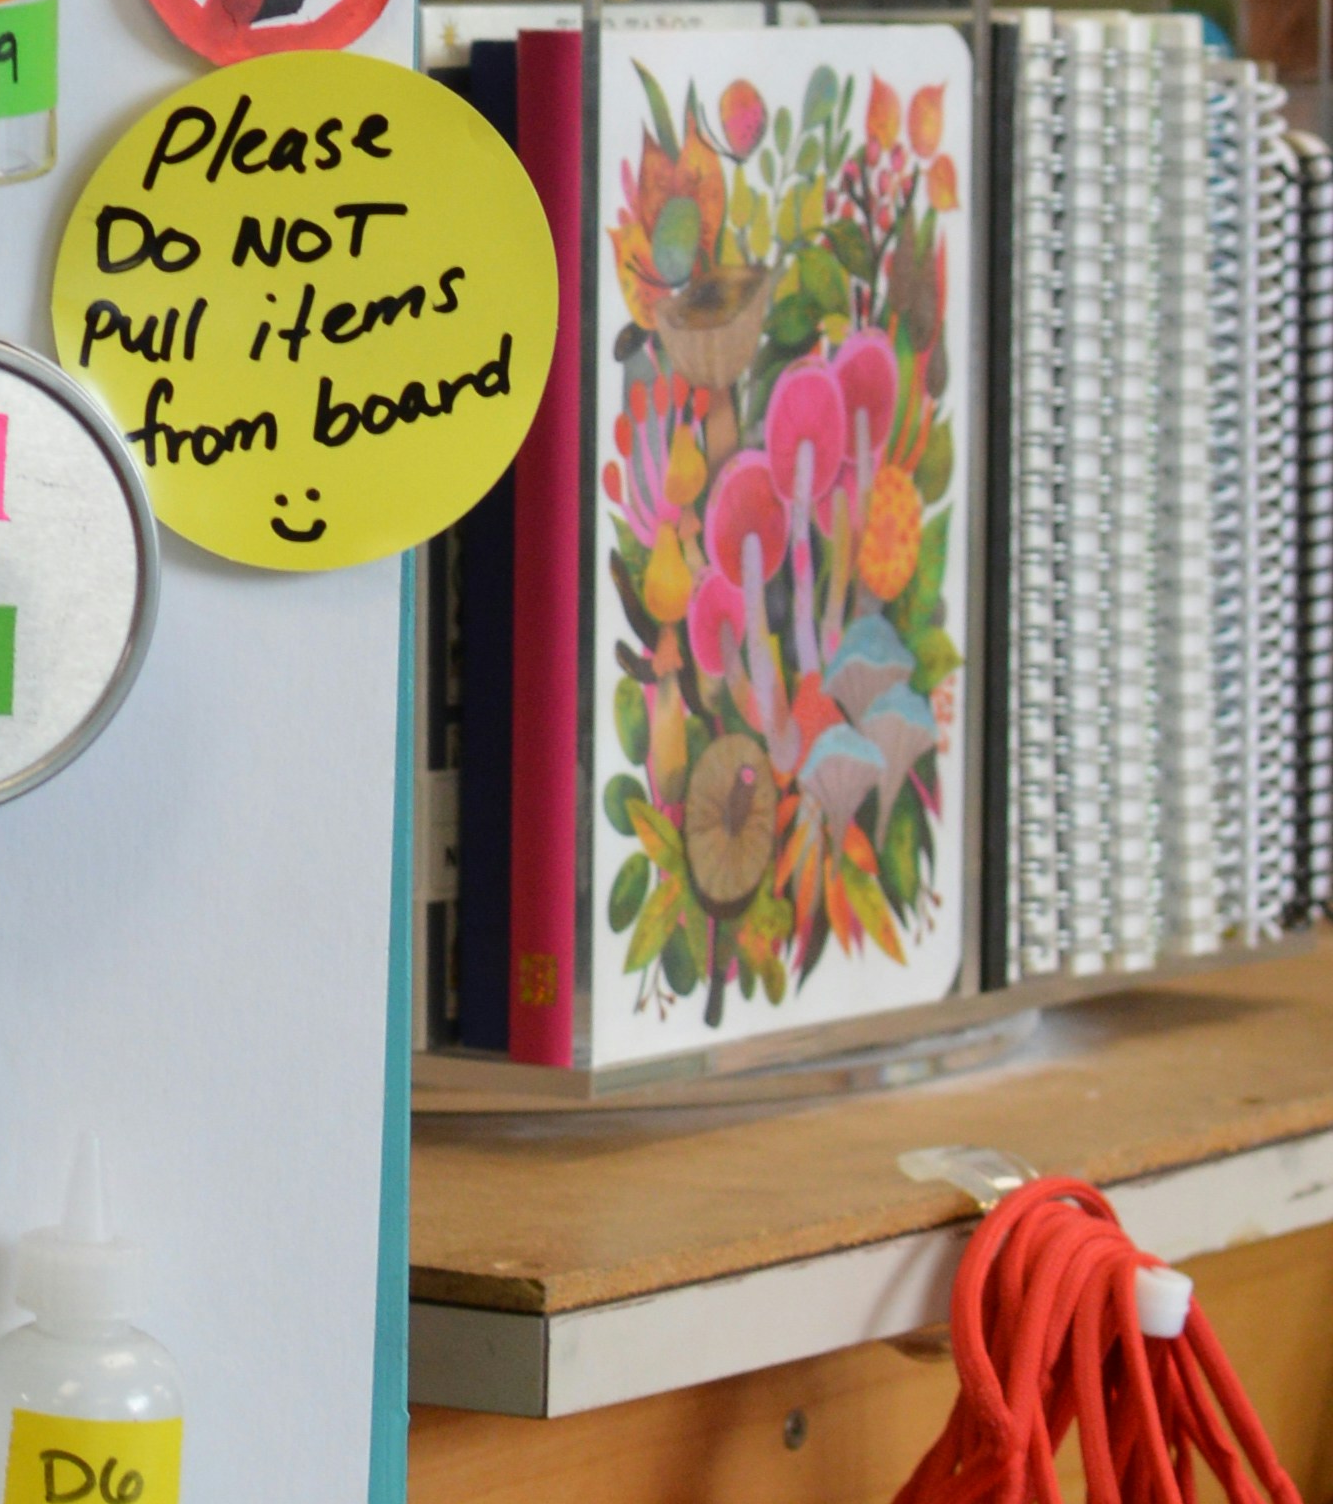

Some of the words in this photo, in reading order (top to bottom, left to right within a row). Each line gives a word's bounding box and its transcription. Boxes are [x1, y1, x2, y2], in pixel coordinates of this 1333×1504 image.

[142, 93, 394, 191] Please
[232, 200, 409, 269] NOT
[249, 265, 467, 363] items
[125, 377, 278, 467] from
[312, 333, 514, 448] board
